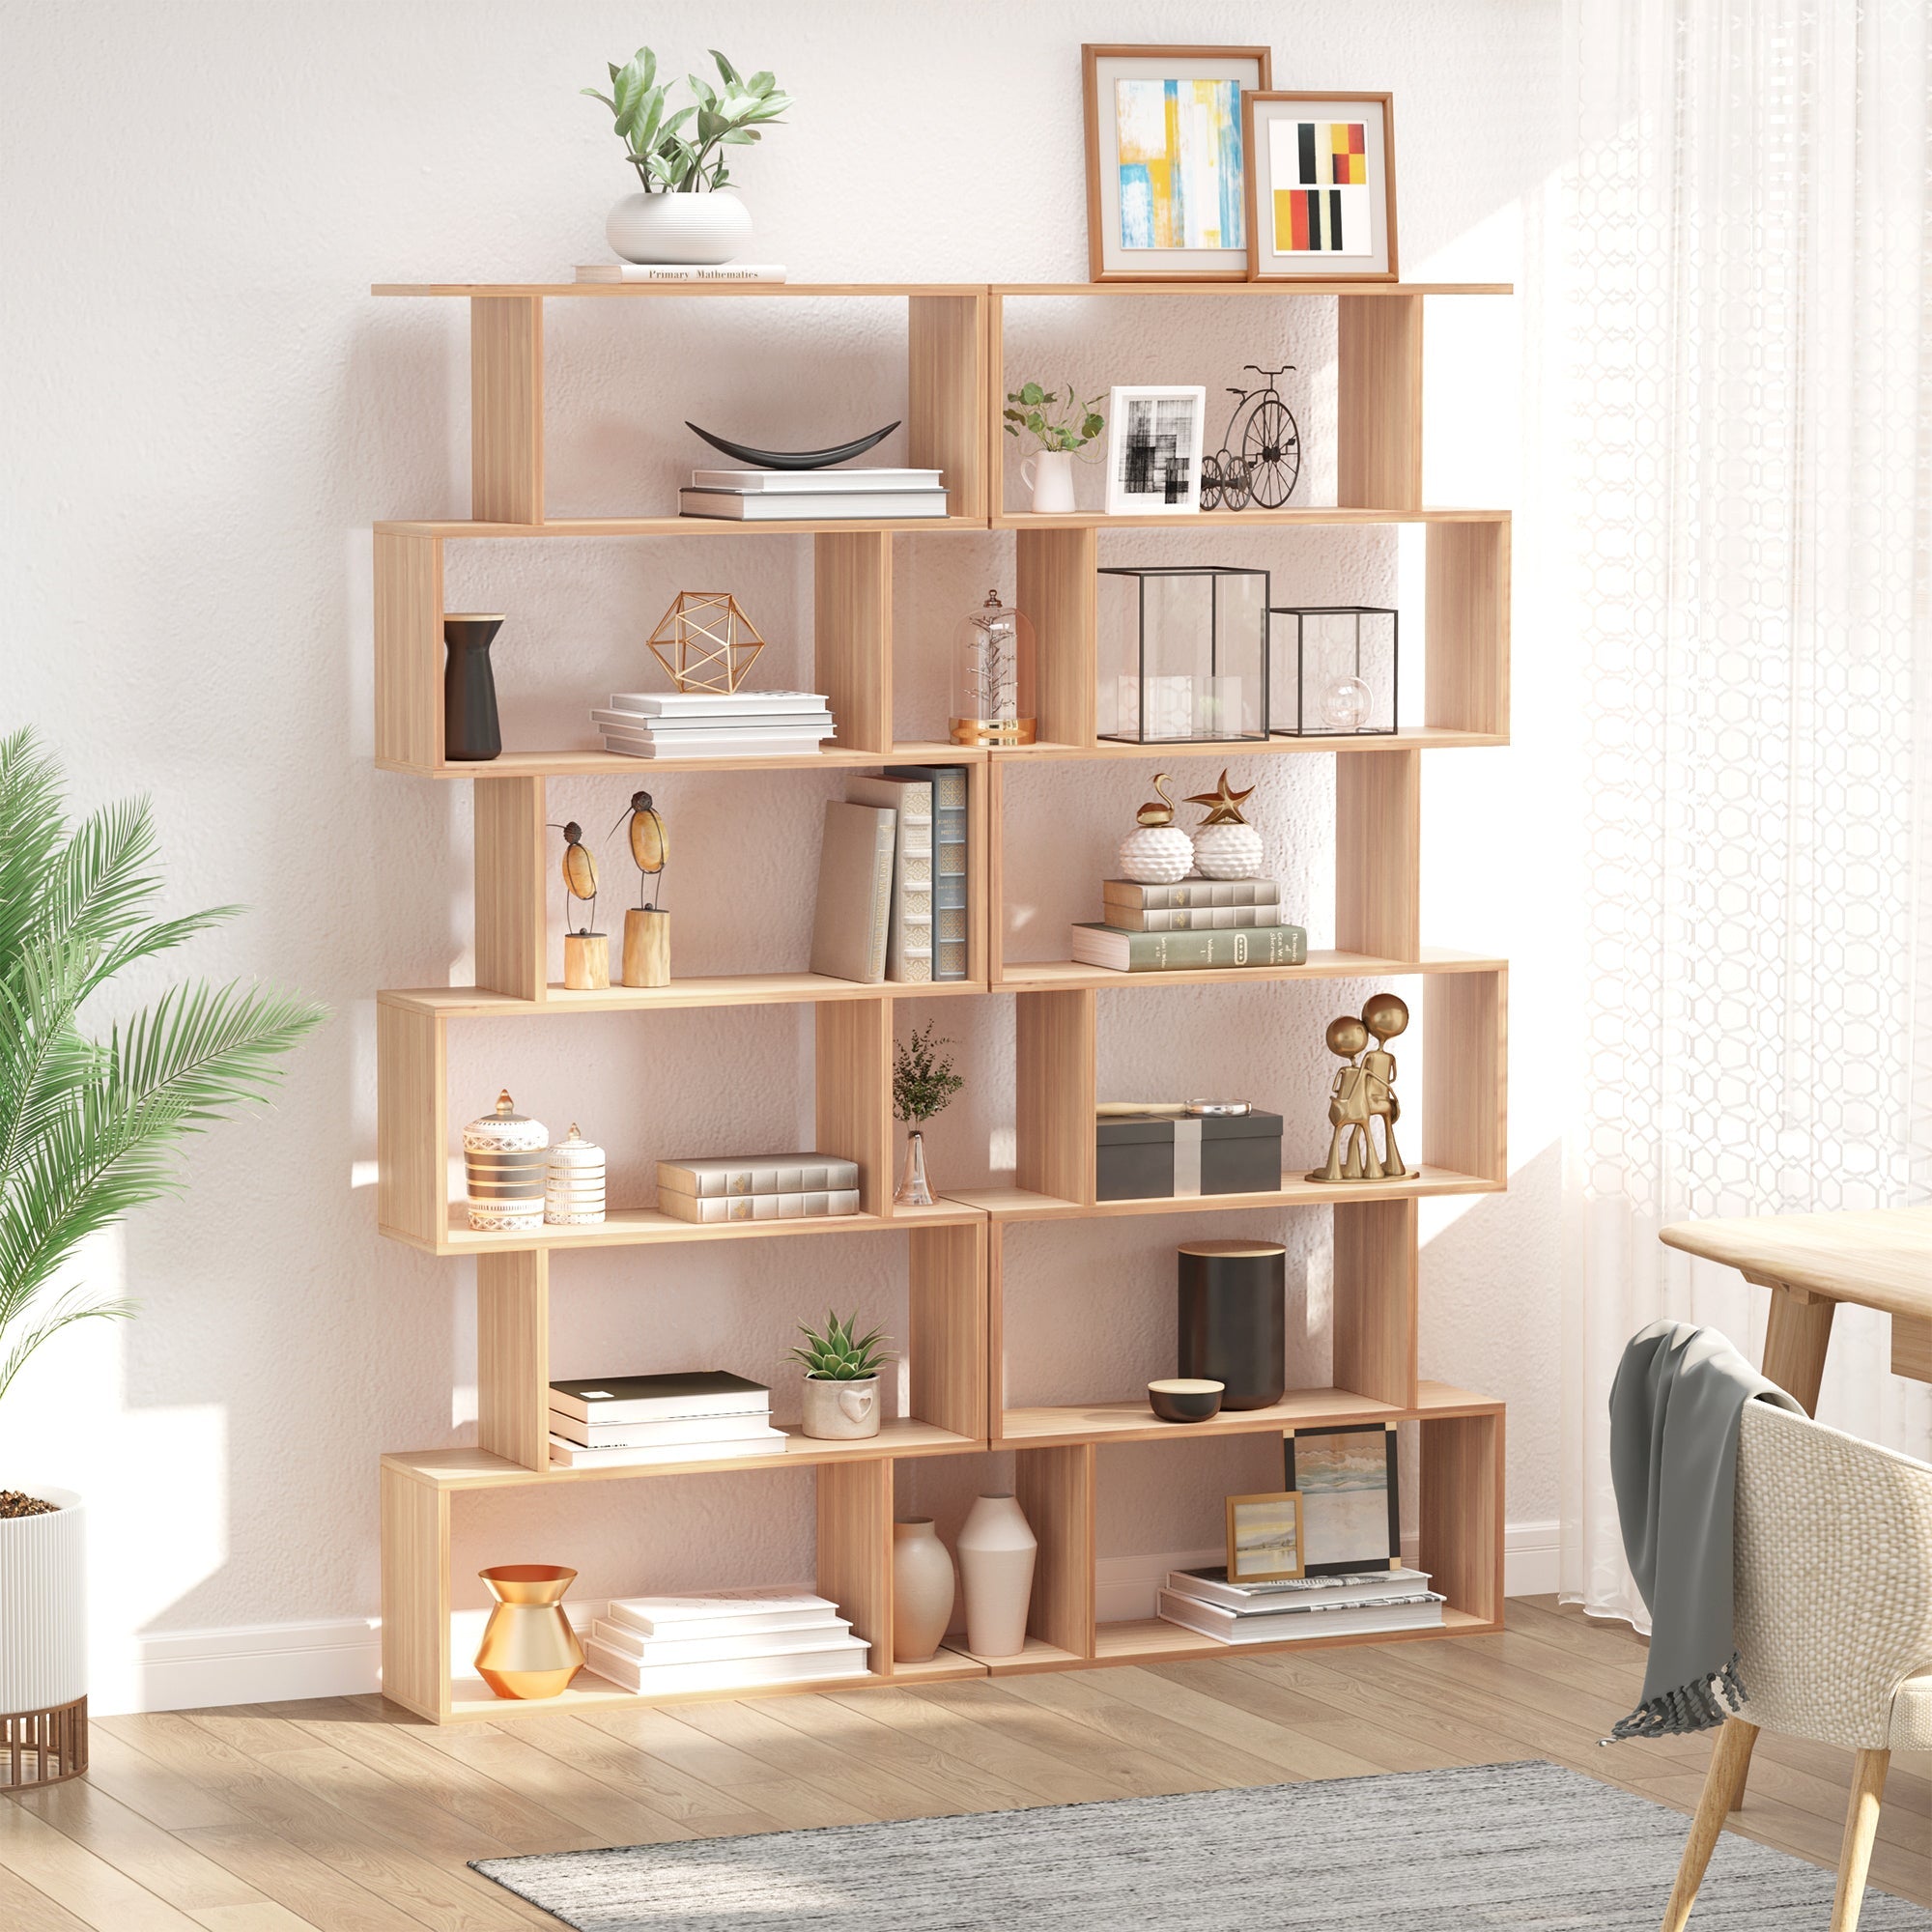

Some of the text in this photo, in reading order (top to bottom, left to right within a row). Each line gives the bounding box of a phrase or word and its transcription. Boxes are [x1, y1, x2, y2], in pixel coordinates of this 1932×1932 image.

[649, 270, 758, 281] Primary Mathematics
[880, 856, 889, 878] LOVE
[878, 880, 887, 894] WE
[875, 895, 887, 927] THINGS
